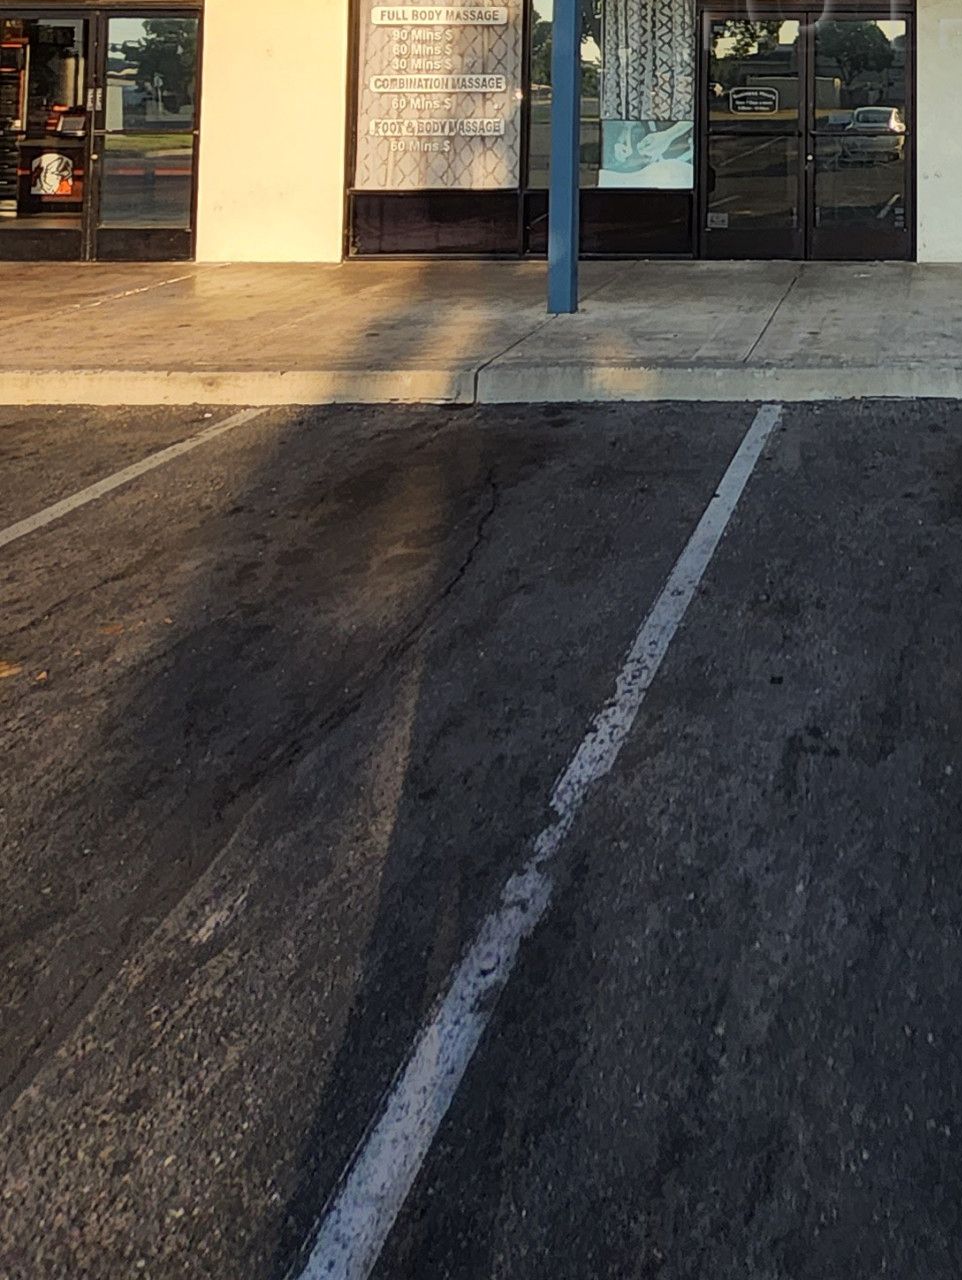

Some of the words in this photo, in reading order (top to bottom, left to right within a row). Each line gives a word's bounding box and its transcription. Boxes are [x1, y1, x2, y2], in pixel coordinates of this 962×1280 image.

[380, 9, 408, 21] FULL
[411, 9, 442, 21] BODY
[445, 9, 500, 21] MASSAGE
[411, 28, 442, 40] Mins
[411, 43, 442, 55] Mins
[411, 58, 441, 70] Mins
[374, 77, 449, 90] COMBINATION
[451, 77, 502, 89] MASSAGE
[391, 97, 407, 109] 60
[410, 97, 440, 109] Mins
[374, 122, 404, 133] FOOT
[406, 122, 414, 133] &
[417, 122, 446, 133] BODY
[448, 121, 501, 133] MASSAGE
[409, 140, 439, 151] Mins
